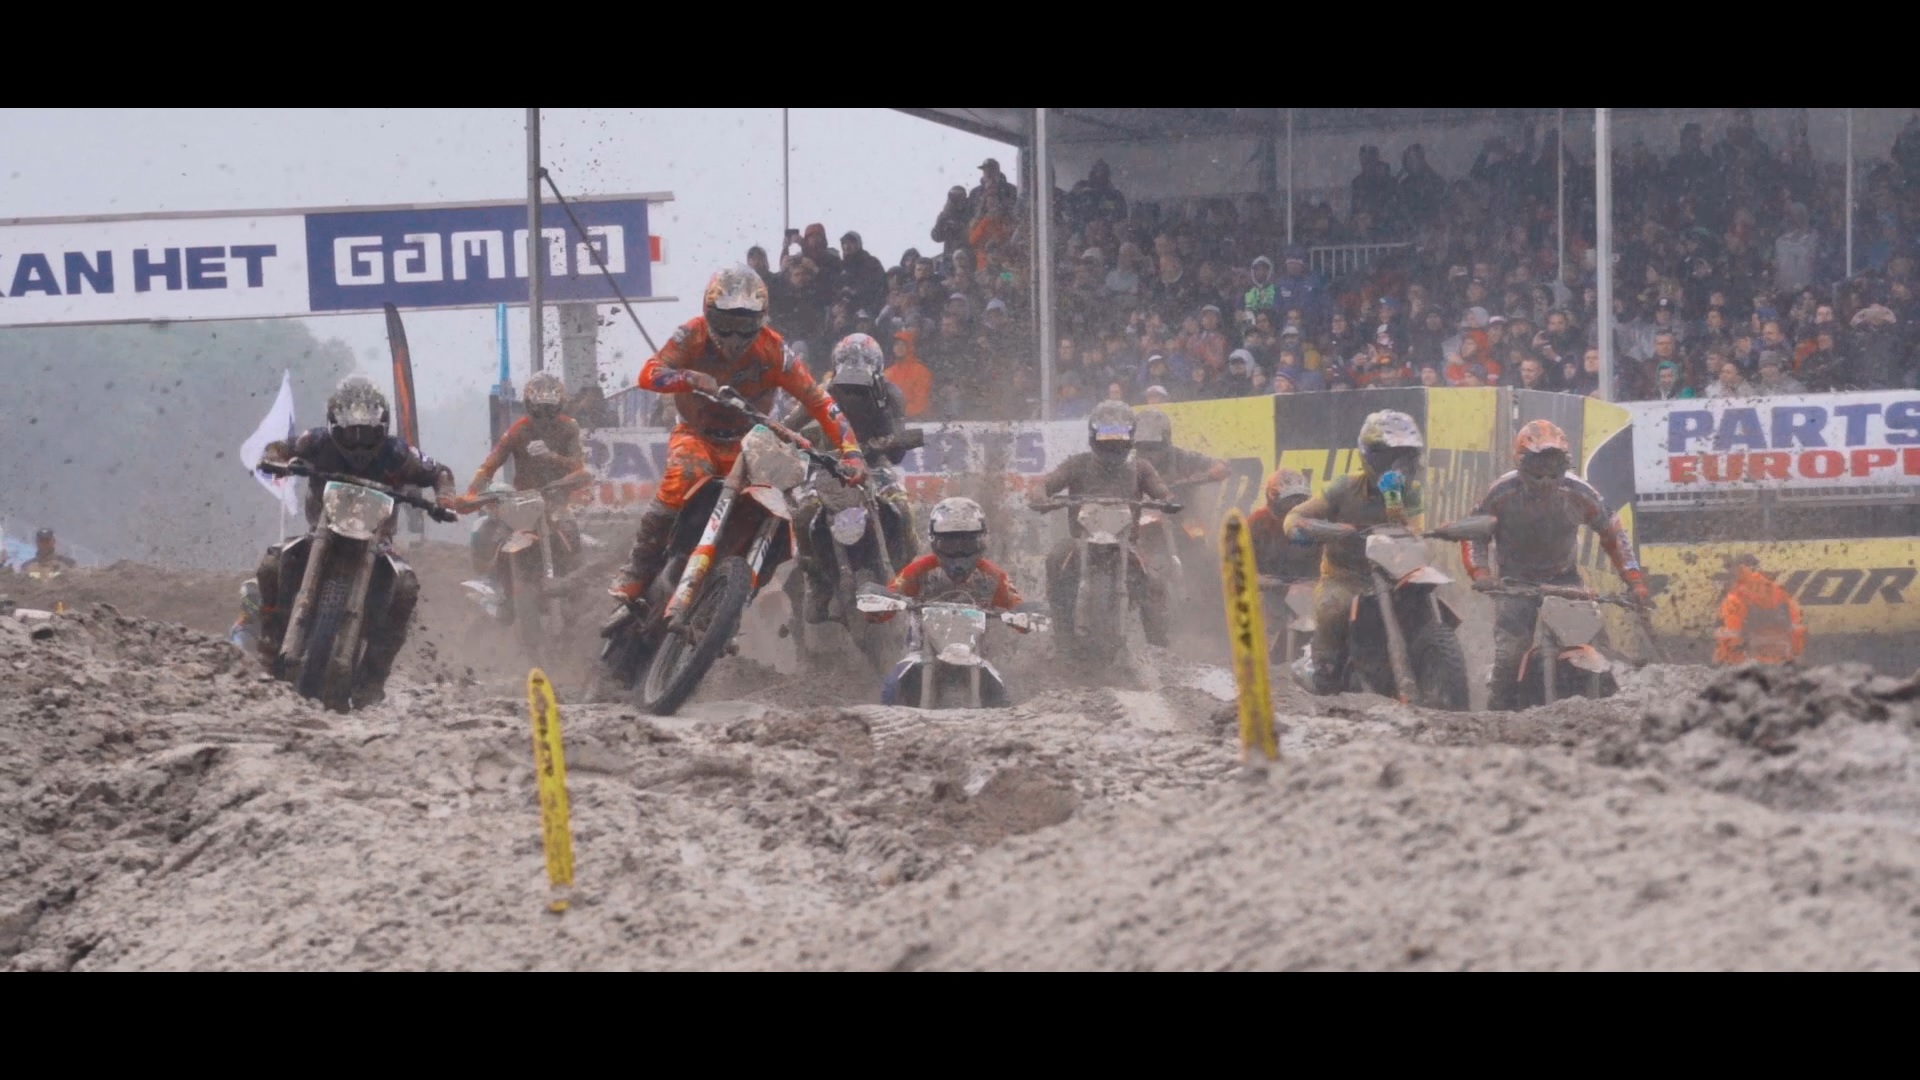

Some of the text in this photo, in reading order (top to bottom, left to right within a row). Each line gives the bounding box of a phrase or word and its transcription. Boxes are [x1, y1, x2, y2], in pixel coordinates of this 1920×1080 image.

[0, 244, 277, 297] AN HET
[1667, 400, 1920, 453] PARTS
